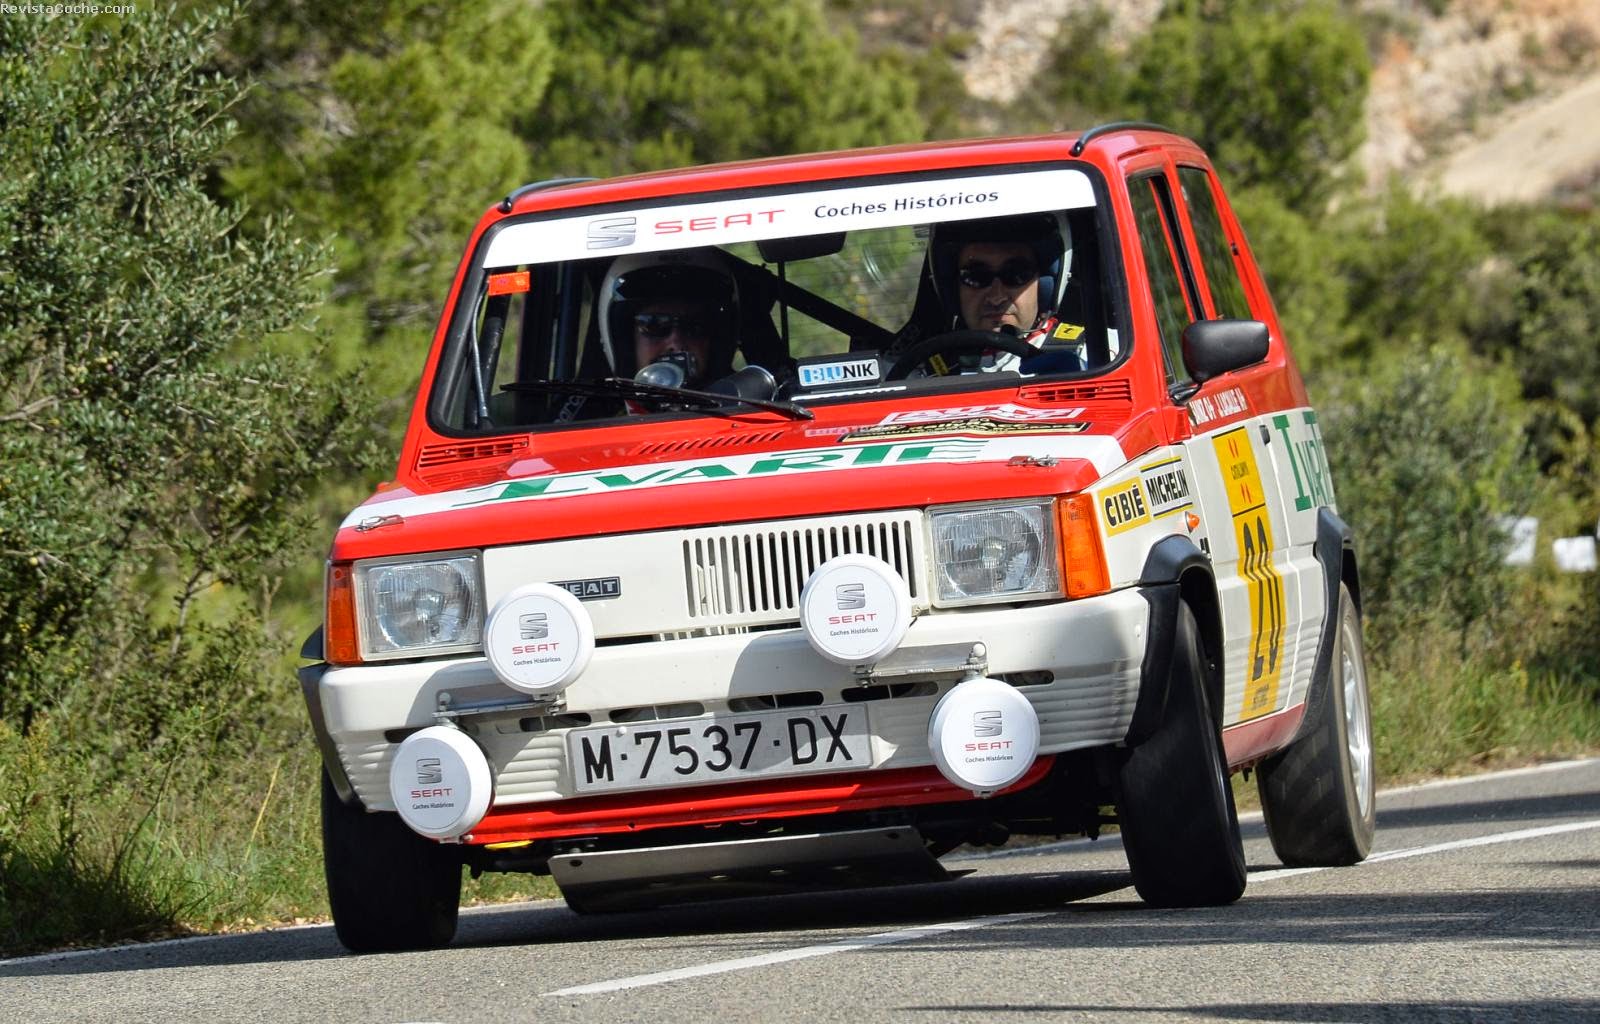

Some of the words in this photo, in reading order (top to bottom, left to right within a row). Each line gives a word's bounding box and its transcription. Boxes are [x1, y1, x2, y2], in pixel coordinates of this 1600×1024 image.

[655, 209, 785, 235] SEAT
[814, 202, 887, 218] Coches
[894, 191, 999, 211] Históricos
[803, 363, 874, 384] BLUNIK
[1146, 469, 1190, 507] MICHELIN
[1104, 485, 1146, 527] CIBIÉ
[562, 581, 616, 595] EAT
[828, 613, 877, 625] SEAT
[830, 629, 850, 637] Coches
[850, 627, 879, 635] Históricos
[512, 642, 560, 655] SEAT
[513, 657, 533, 666] Coches
[965, 740, 1013, 752] SEAT
[985, 754, 1014, 762] Históricos
[411, 788, 453, 799] SEAT
